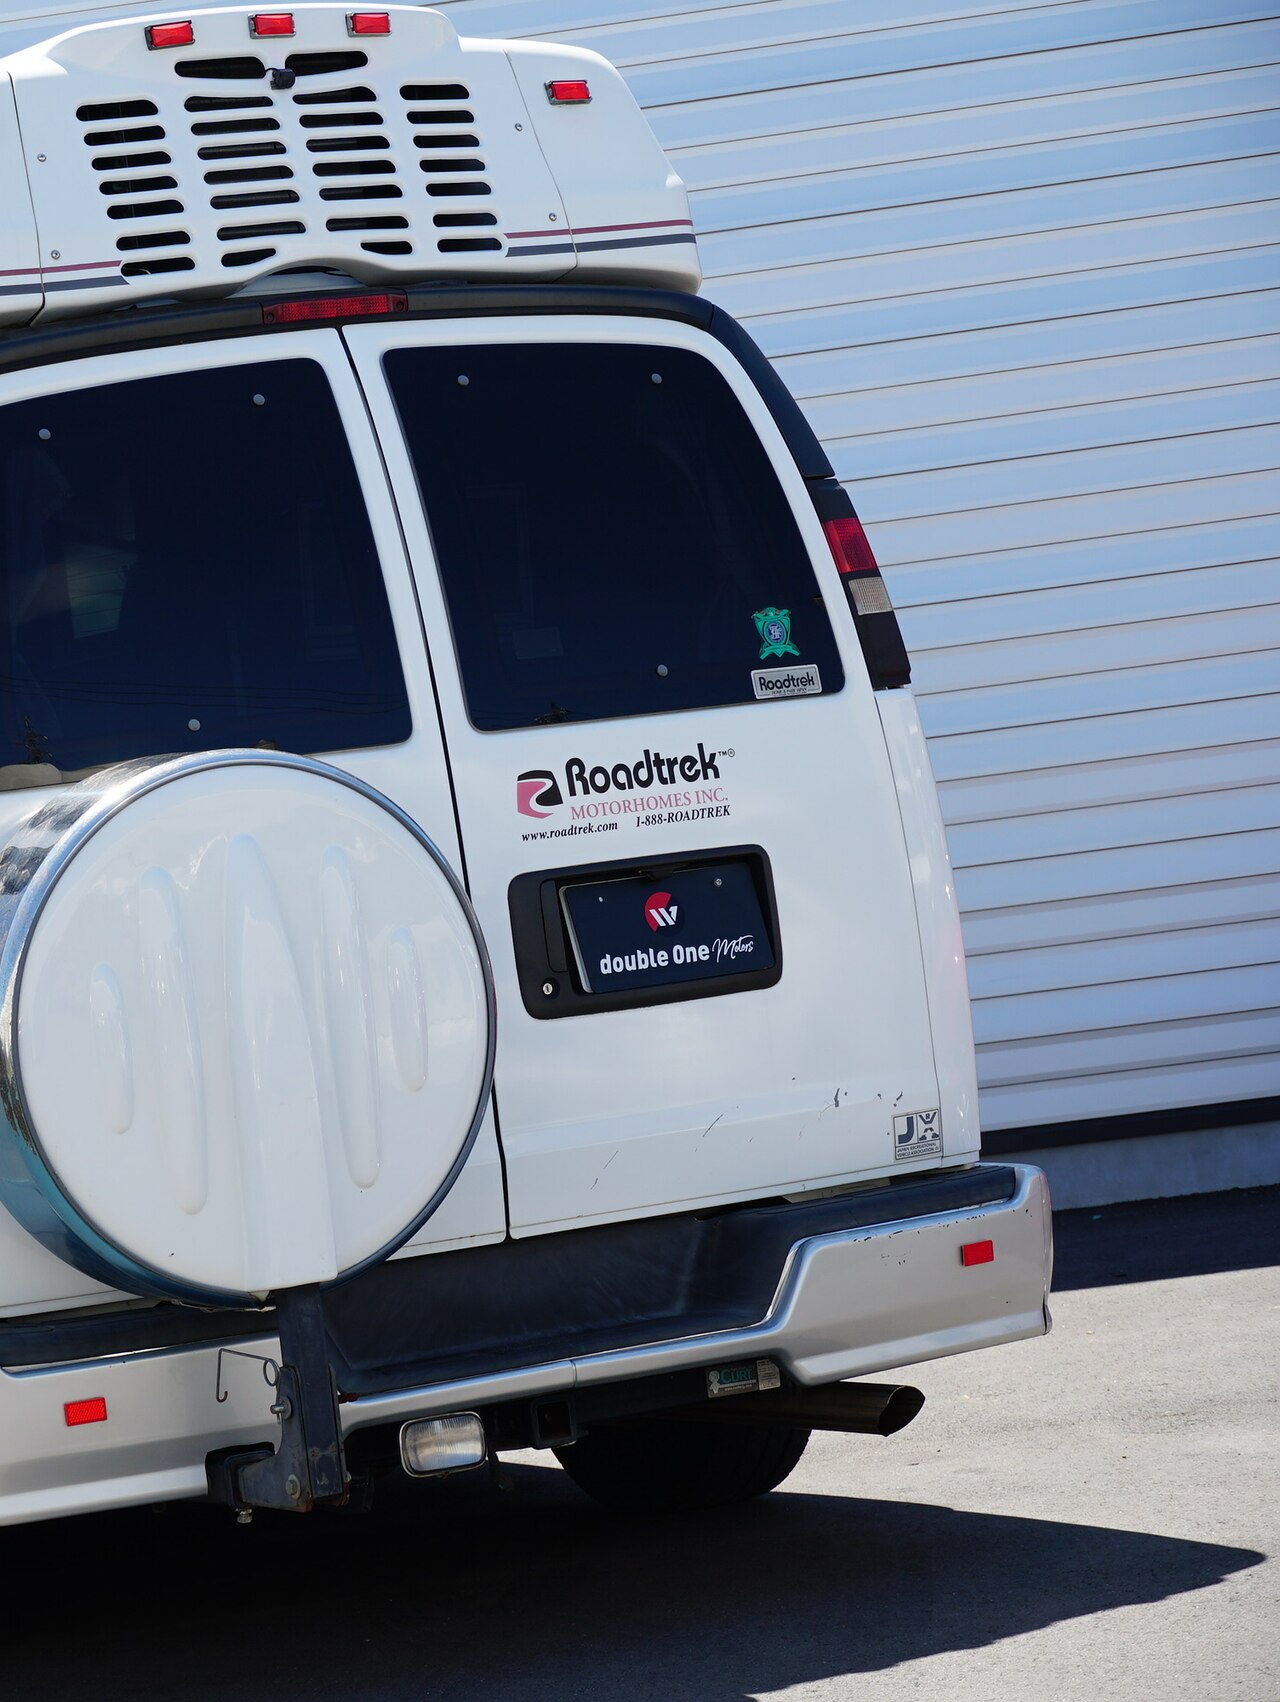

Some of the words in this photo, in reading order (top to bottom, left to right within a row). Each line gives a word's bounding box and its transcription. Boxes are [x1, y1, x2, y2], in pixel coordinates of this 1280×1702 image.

[758, 672, 815, 691] Roadtrek
[565, 743, 721, 797] Roadtrek
[571, 791, 692, 820] MOTORHOMES
[695, 787, 729, 805] INC.
[521, 821, 618, 842] www.roadtrek.com
[636, 805, 731, 827] 1-888-ROADTREK
[600, 948, 669, 975] double
[672, 944, 710, 965] One
[712, 935, 754, 963] Motors
